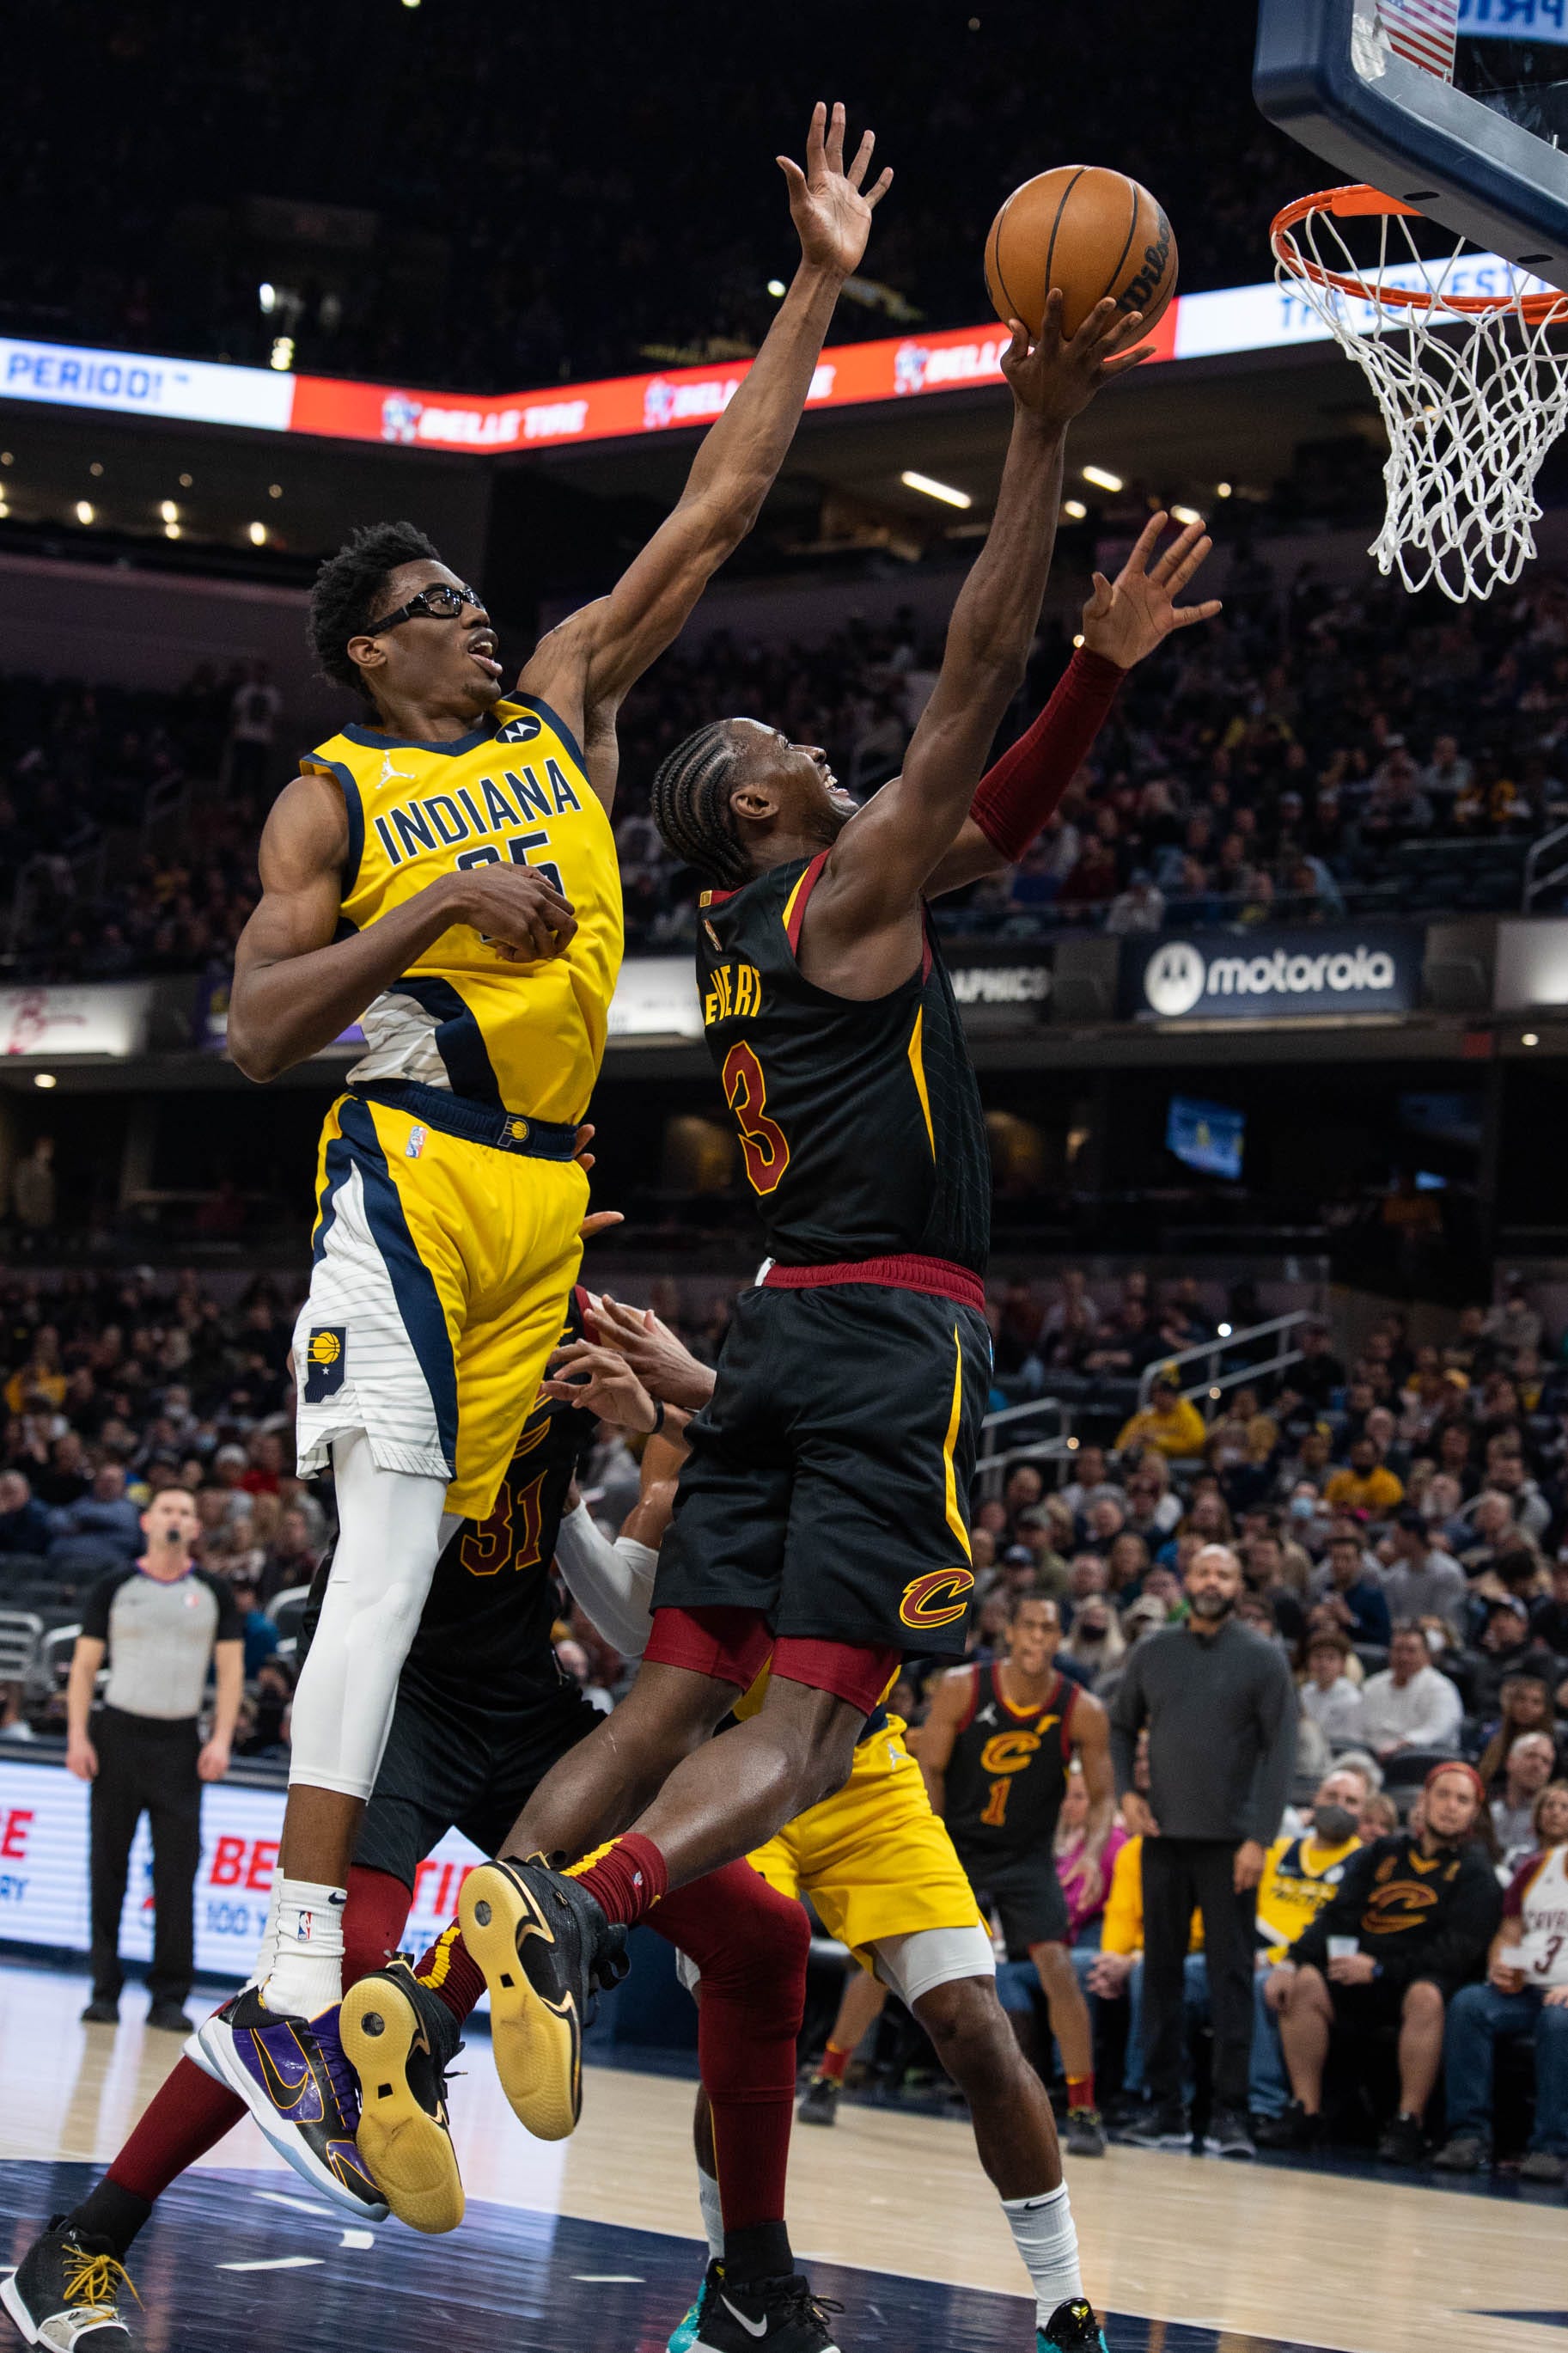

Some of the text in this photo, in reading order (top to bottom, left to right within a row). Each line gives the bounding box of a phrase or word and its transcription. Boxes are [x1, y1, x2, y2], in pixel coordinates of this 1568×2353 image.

[373, 756, 583, 868] INDIANA
[697, 964, 761, 1026] EVERT
[1206, 944, 1395, 996] motorola
[722, 1039, 790, 1196] 3
[460, 1469, 549, 1577] 31
[980, 1775, 1012, 1827] 1
[1533, 1934, 1565, 1976] 3
